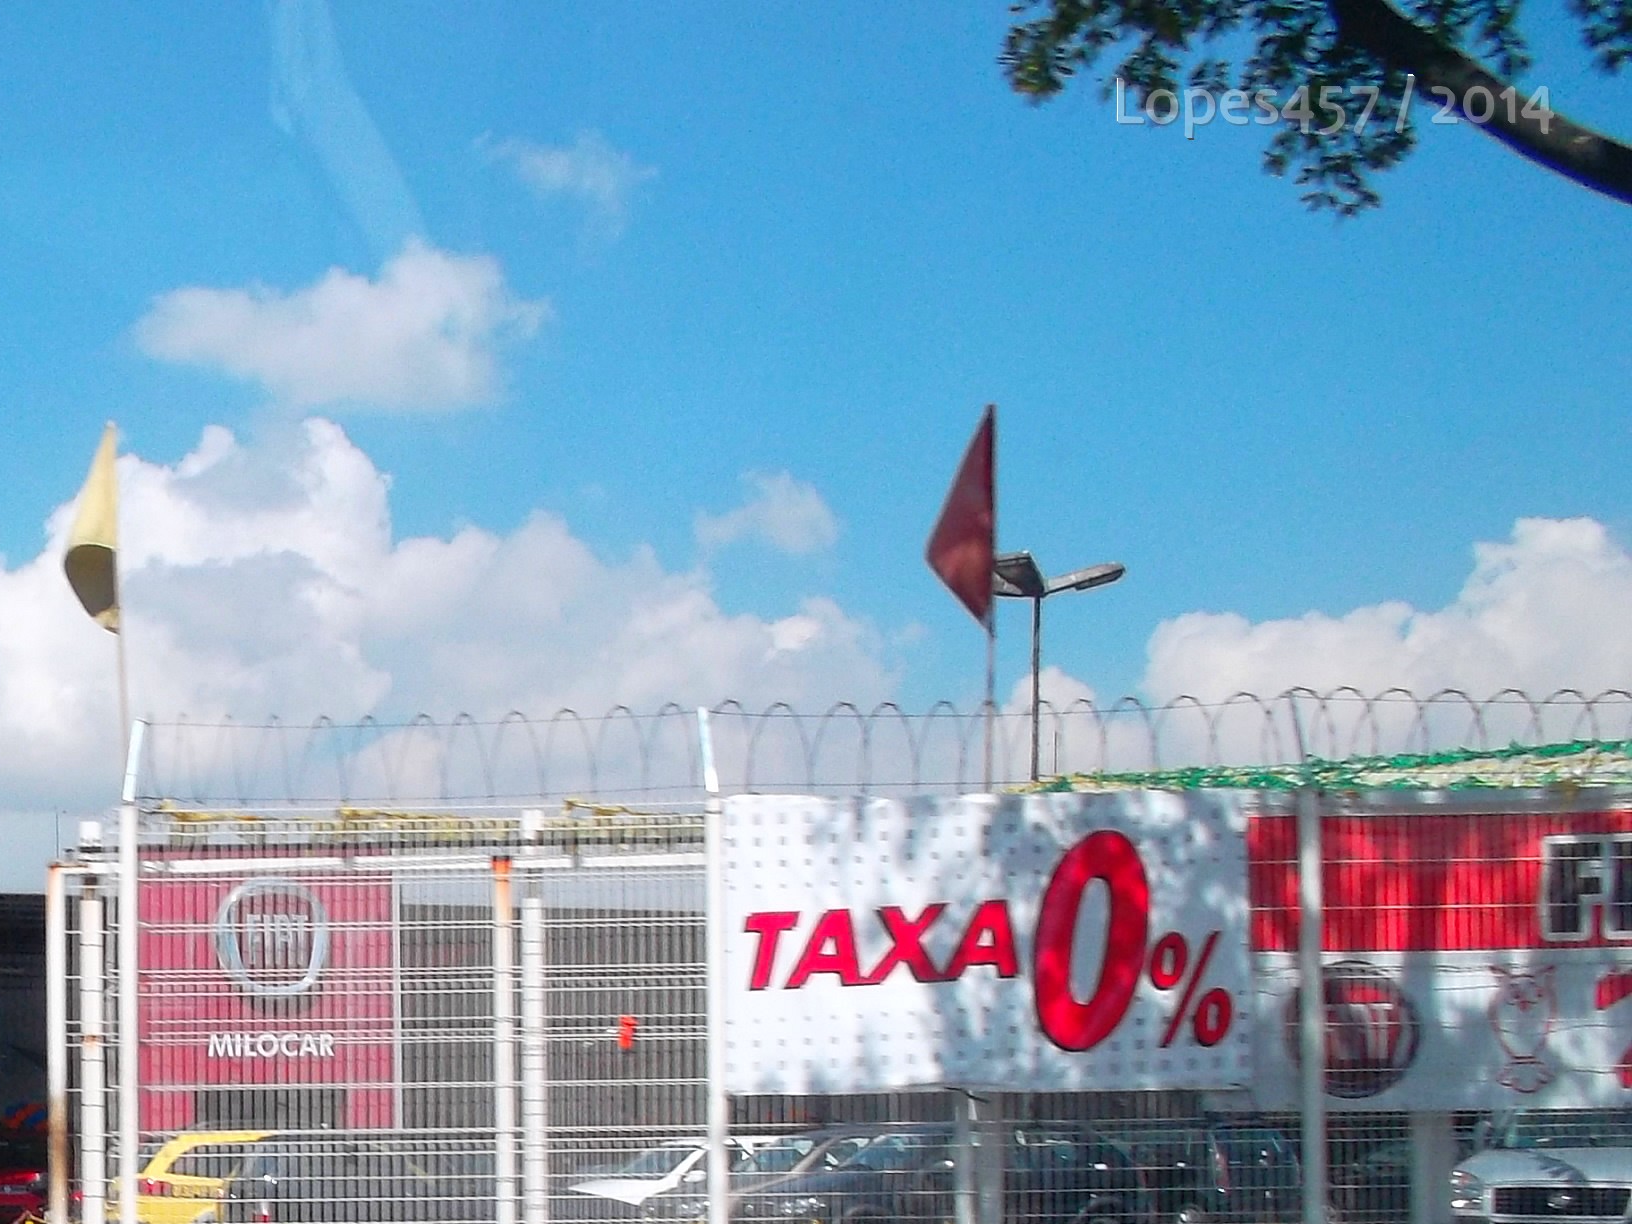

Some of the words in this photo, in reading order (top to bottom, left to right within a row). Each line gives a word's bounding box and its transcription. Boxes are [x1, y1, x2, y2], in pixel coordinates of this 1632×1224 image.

[246, 914, 309, 966] FIAT
[744, 900, 1019, 991] TAXA
[1033, 829, 1234, 1052] 0%
[208, 1033, 335, 1058] MILOCAR
